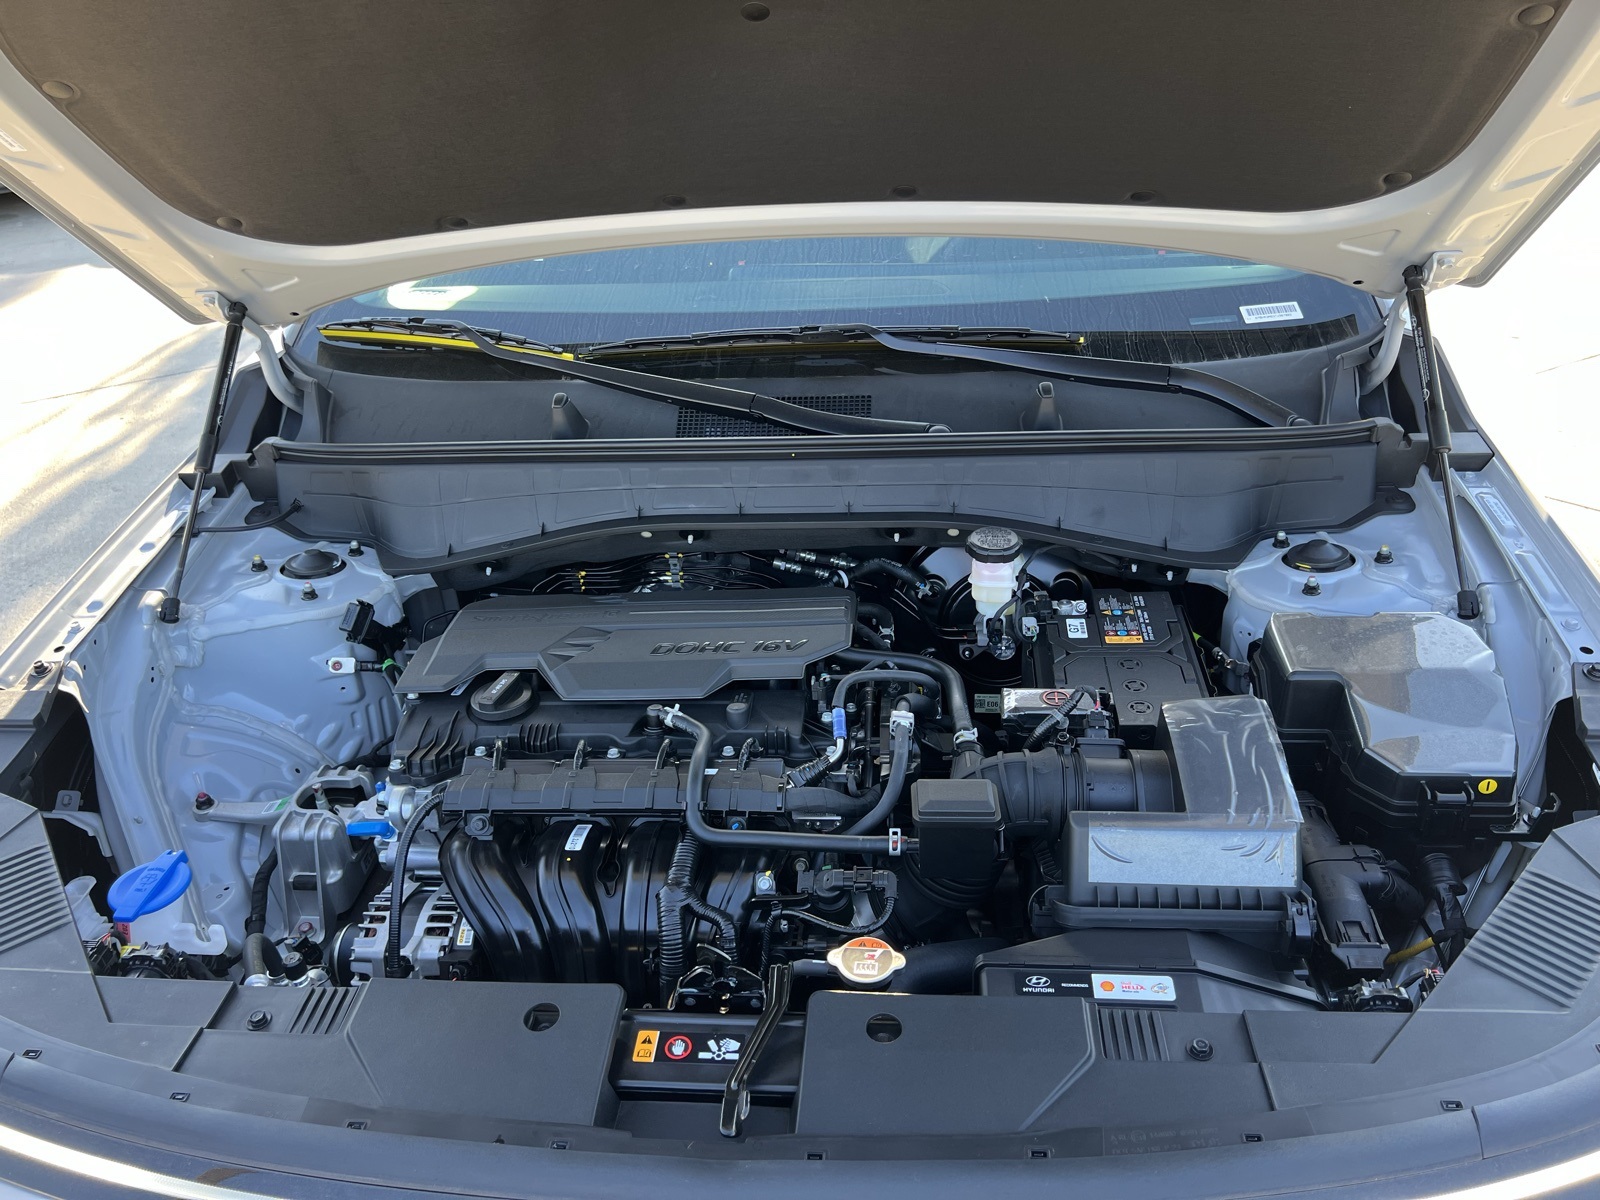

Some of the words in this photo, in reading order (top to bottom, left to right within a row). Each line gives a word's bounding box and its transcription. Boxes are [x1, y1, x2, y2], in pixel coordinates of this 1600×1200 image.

[1068, 623, 1080, 633] G7
[649, 640, 746, 656] DOHC
[752, 638, 809, 652] 16V
[986, 700, 999, 708] E06
